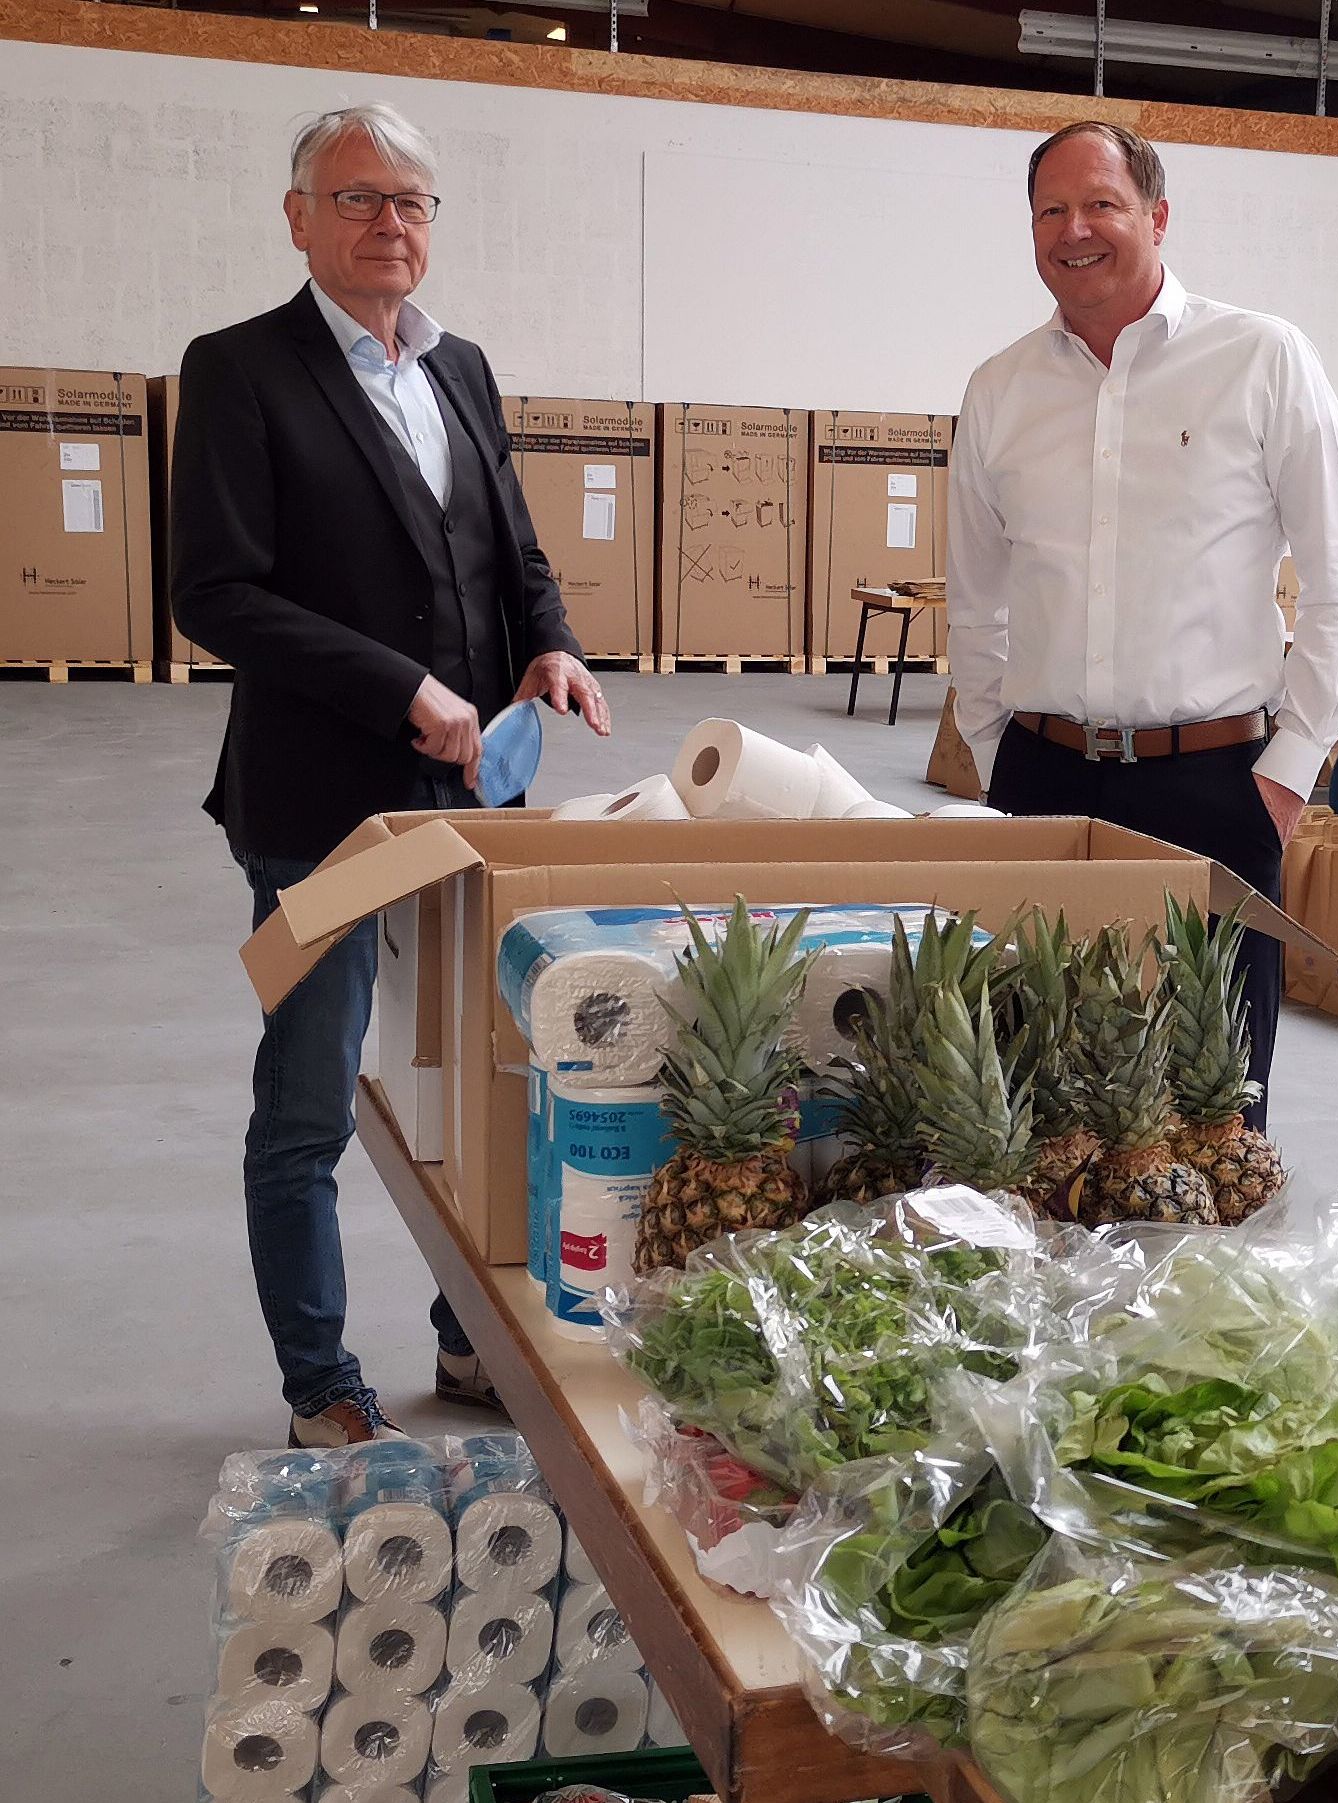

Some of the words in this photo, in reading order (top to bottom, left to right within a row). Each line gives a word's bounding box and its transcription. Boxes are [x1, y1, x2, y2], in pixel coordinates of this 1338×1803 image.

[57, 388, 133, 401] Solarmodule
[583, 415, 643, 426] Solarmodule
[741, 421, 798, 432] Solarmodule
[887, 427, 942, 438] Solarmodule
[569, 1109, 627, 1123] 2054695
[569, 1144, 596, 1160] 100
[600, 1146, 630, 1160] ECO
[588, 1245, 600, 1260] 2
